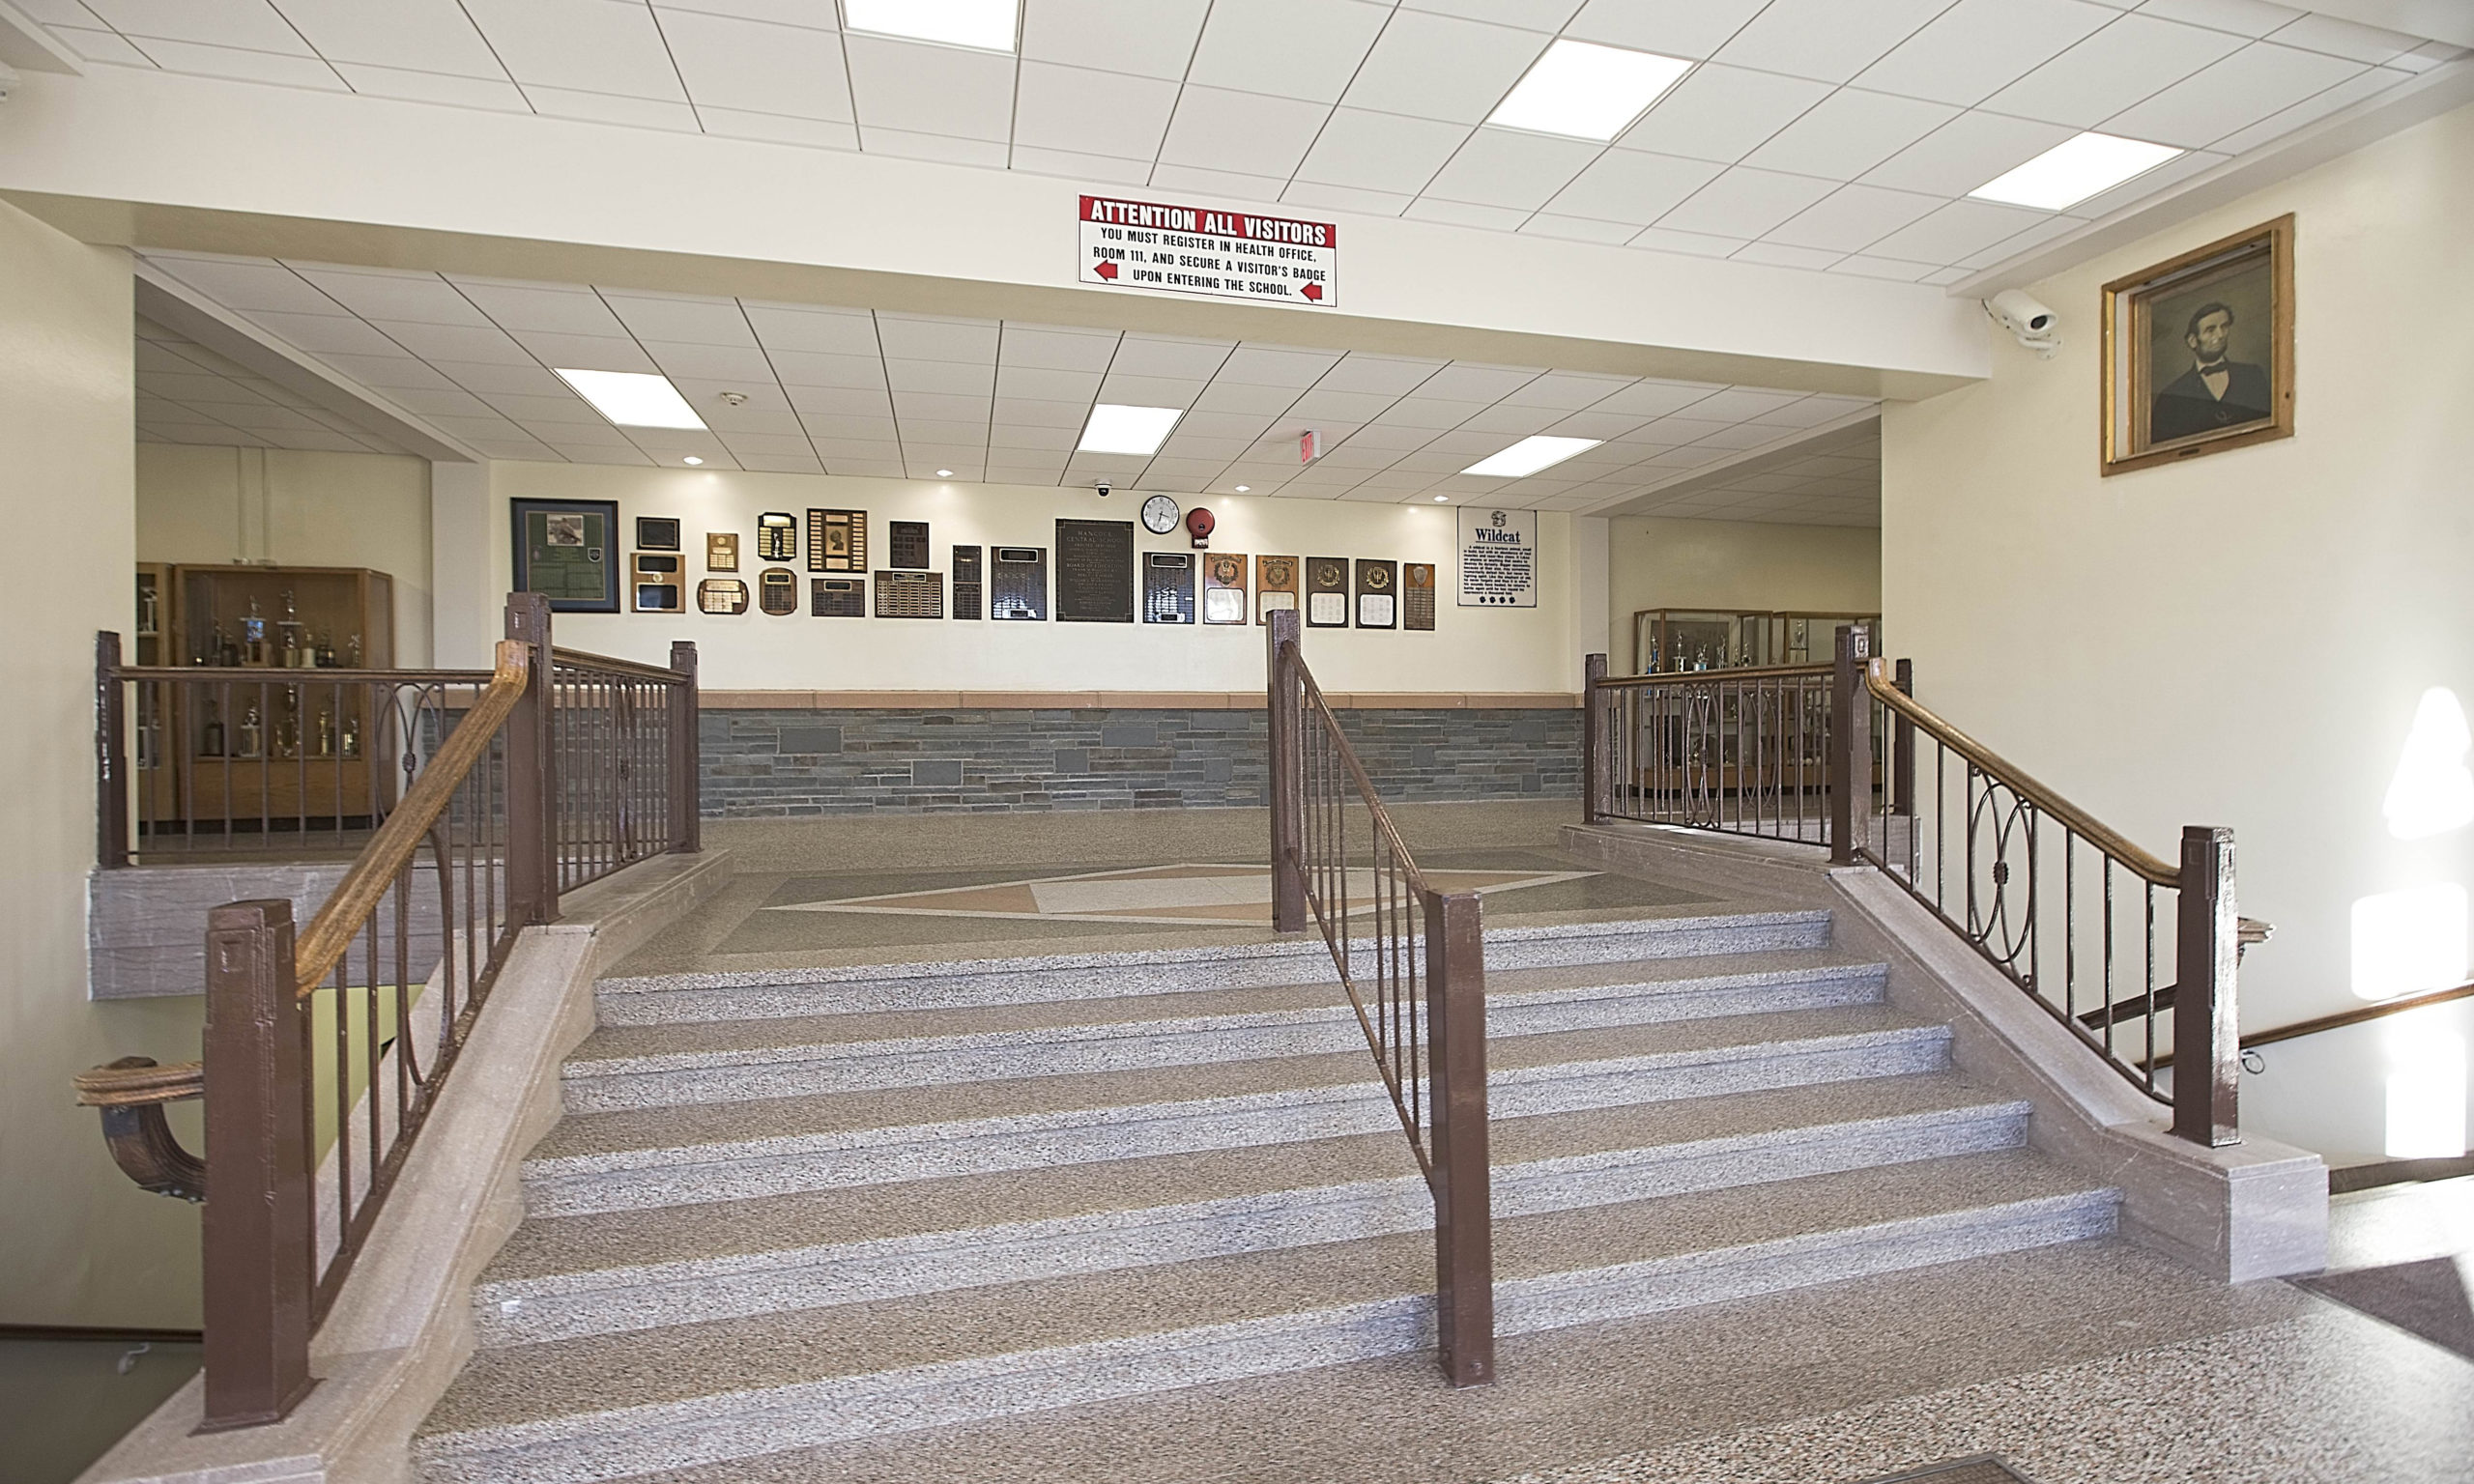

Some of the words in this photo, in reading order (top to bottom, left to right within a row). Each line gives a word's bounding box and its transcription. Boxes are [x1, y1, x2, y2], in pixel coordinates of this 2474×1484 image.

[1091, 200, 1196, 230] ATTENTION
[1205, 213, 1237, 235] ALL
[1244, 217, 1326, 245] VISITORS
[1101, 227, 1122, 241] YOU
[1128, 230, 1158, 243] MUST
[1164, 235, 1215, 250] REGISTER
[1221, 241, 1230, 252] IN
[1236, 243, 1274, 256] HEALTH
[1279, 248, 1316, 263] OFFICE,
[1094, 247, 1125, 260] ROOM
[1131, 250, 1147, 263] 111,
[1152, 253, 1174, 264] AND
[1180, 255, 1220, 270] SECURE
[1226, 260, 1232, 271] A
[1237, 262, 1287, 277] VISITOR'S
[1293, 268, 1326, 281] BADGE
[1134, 270, 1162, 282] UPON
[1167, 273, 1220, 289] ENTERING
[1224, 279, 1244, 291] THE
[1250, 281, 1292, 296] SCHOOL.
[1476, 528, 1520, 542] Wildcat
